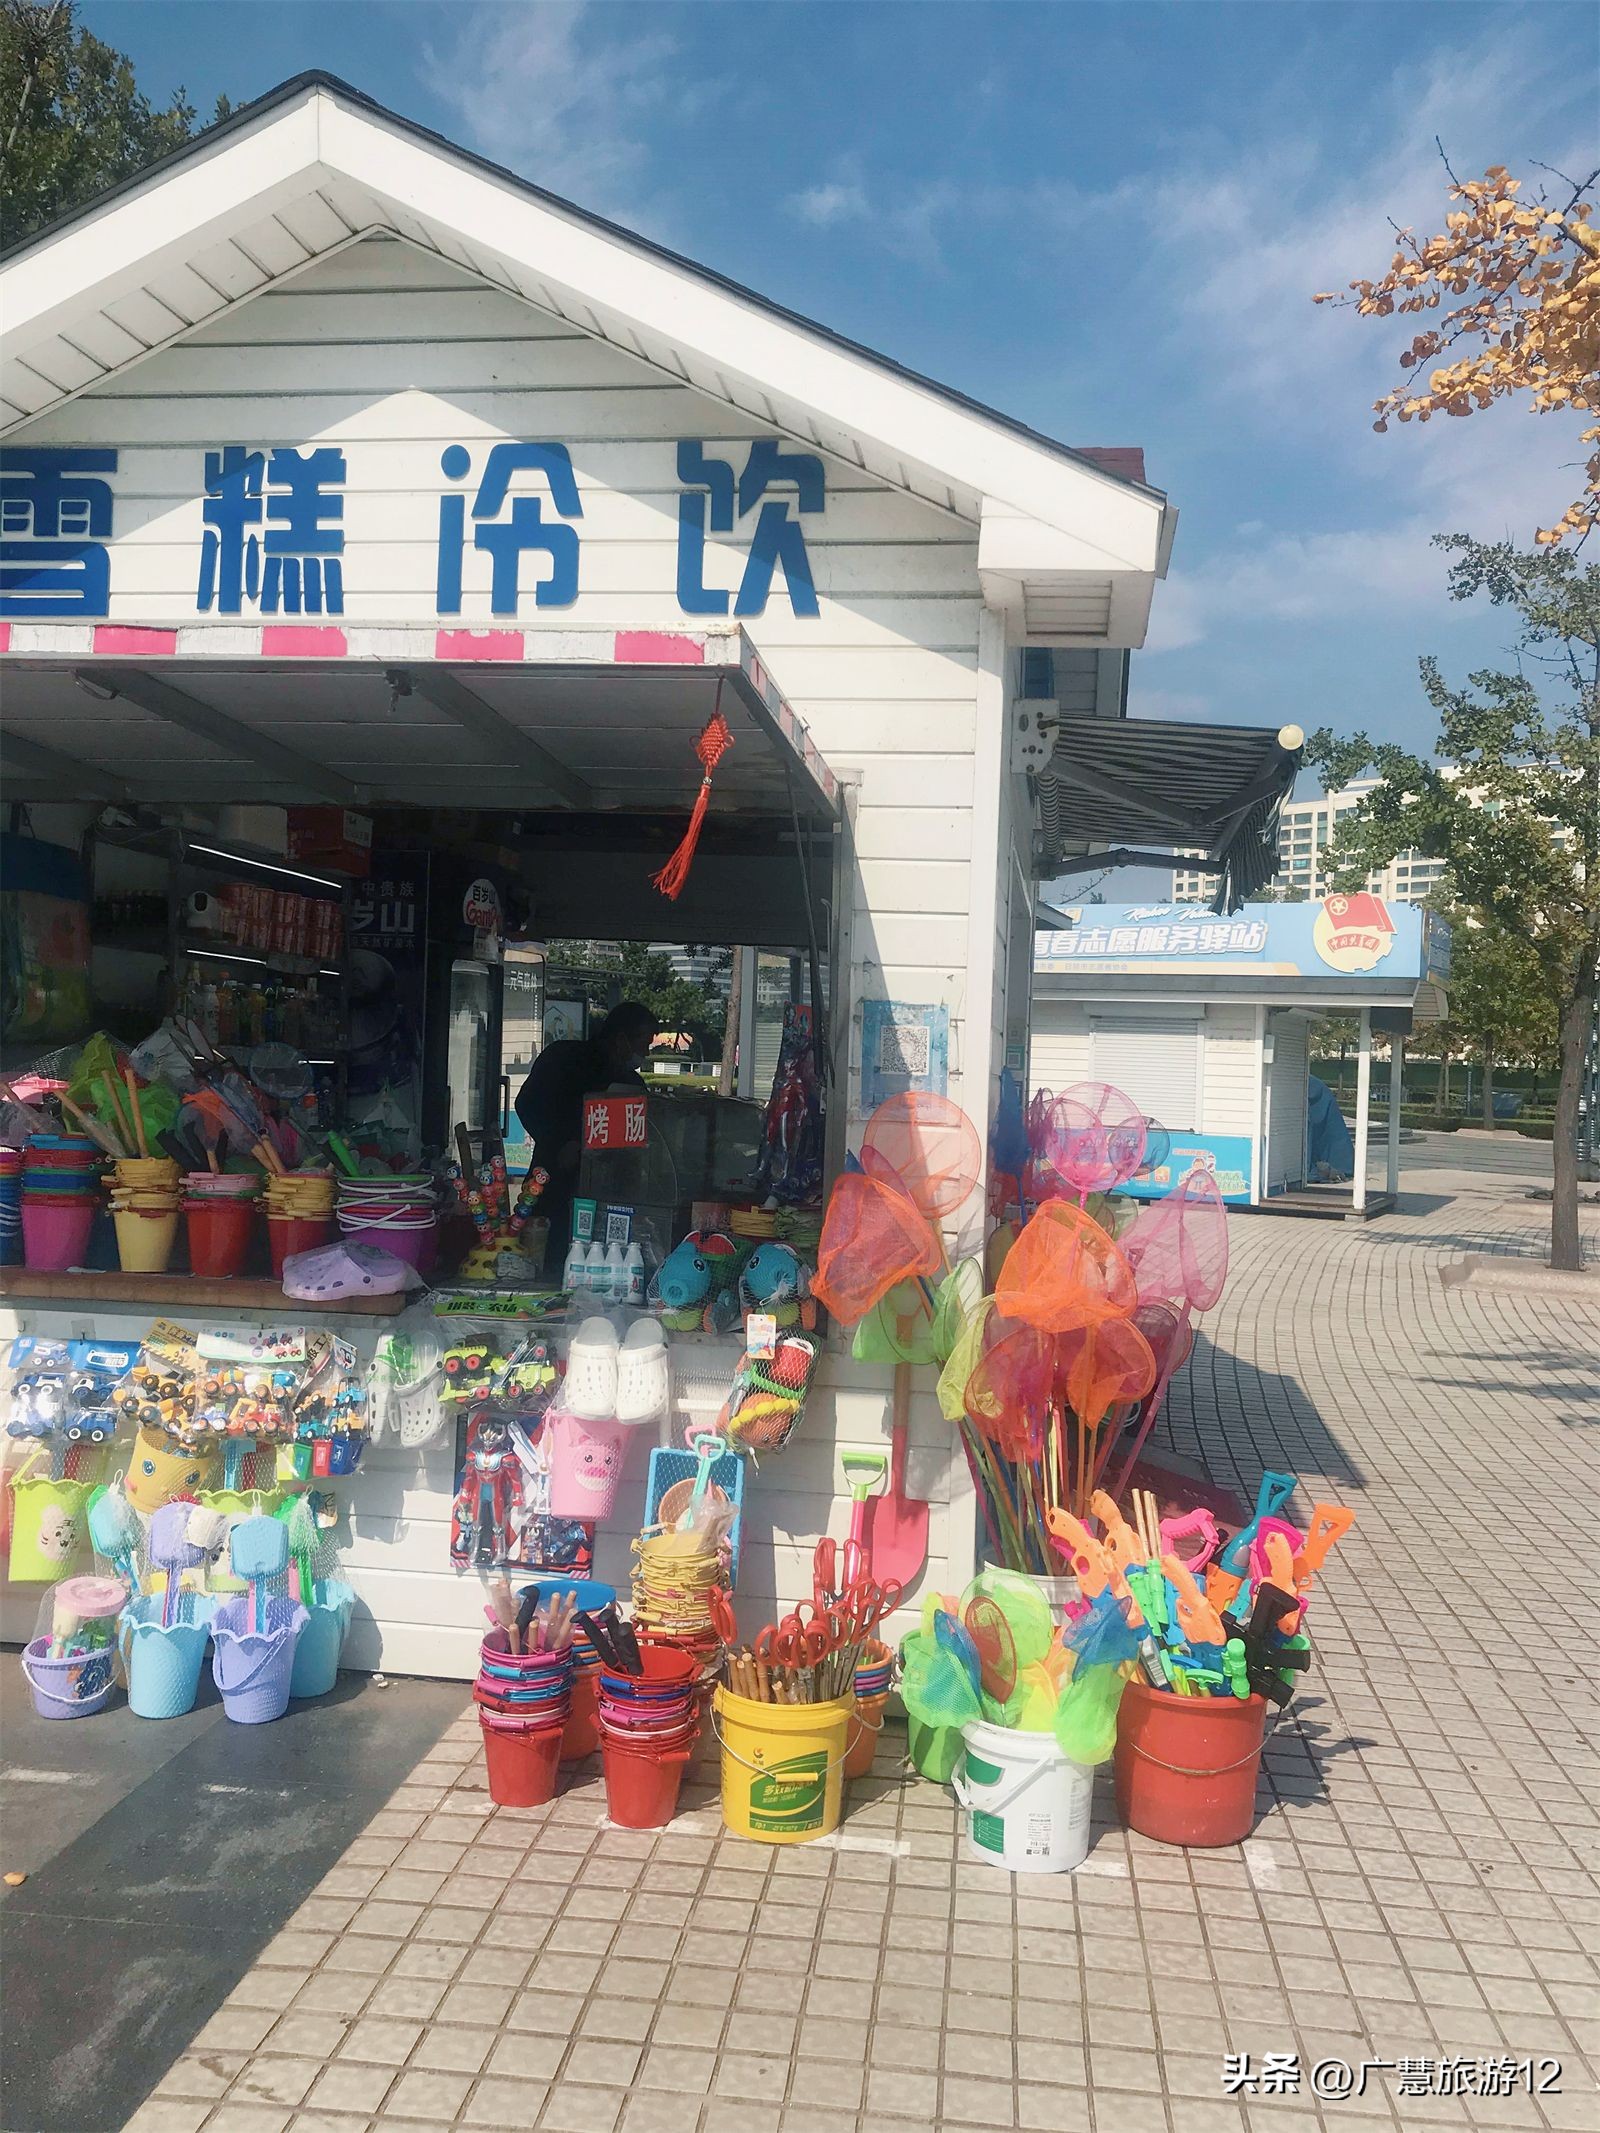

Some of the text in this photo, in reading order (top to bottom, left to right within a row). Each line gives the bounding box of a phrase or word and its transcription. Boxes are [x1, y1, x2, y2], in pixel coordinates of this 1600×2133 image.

[0, 440, 826, 617] 雪糕冷饮
[587, 1103, 646, 1145] 烤肠
